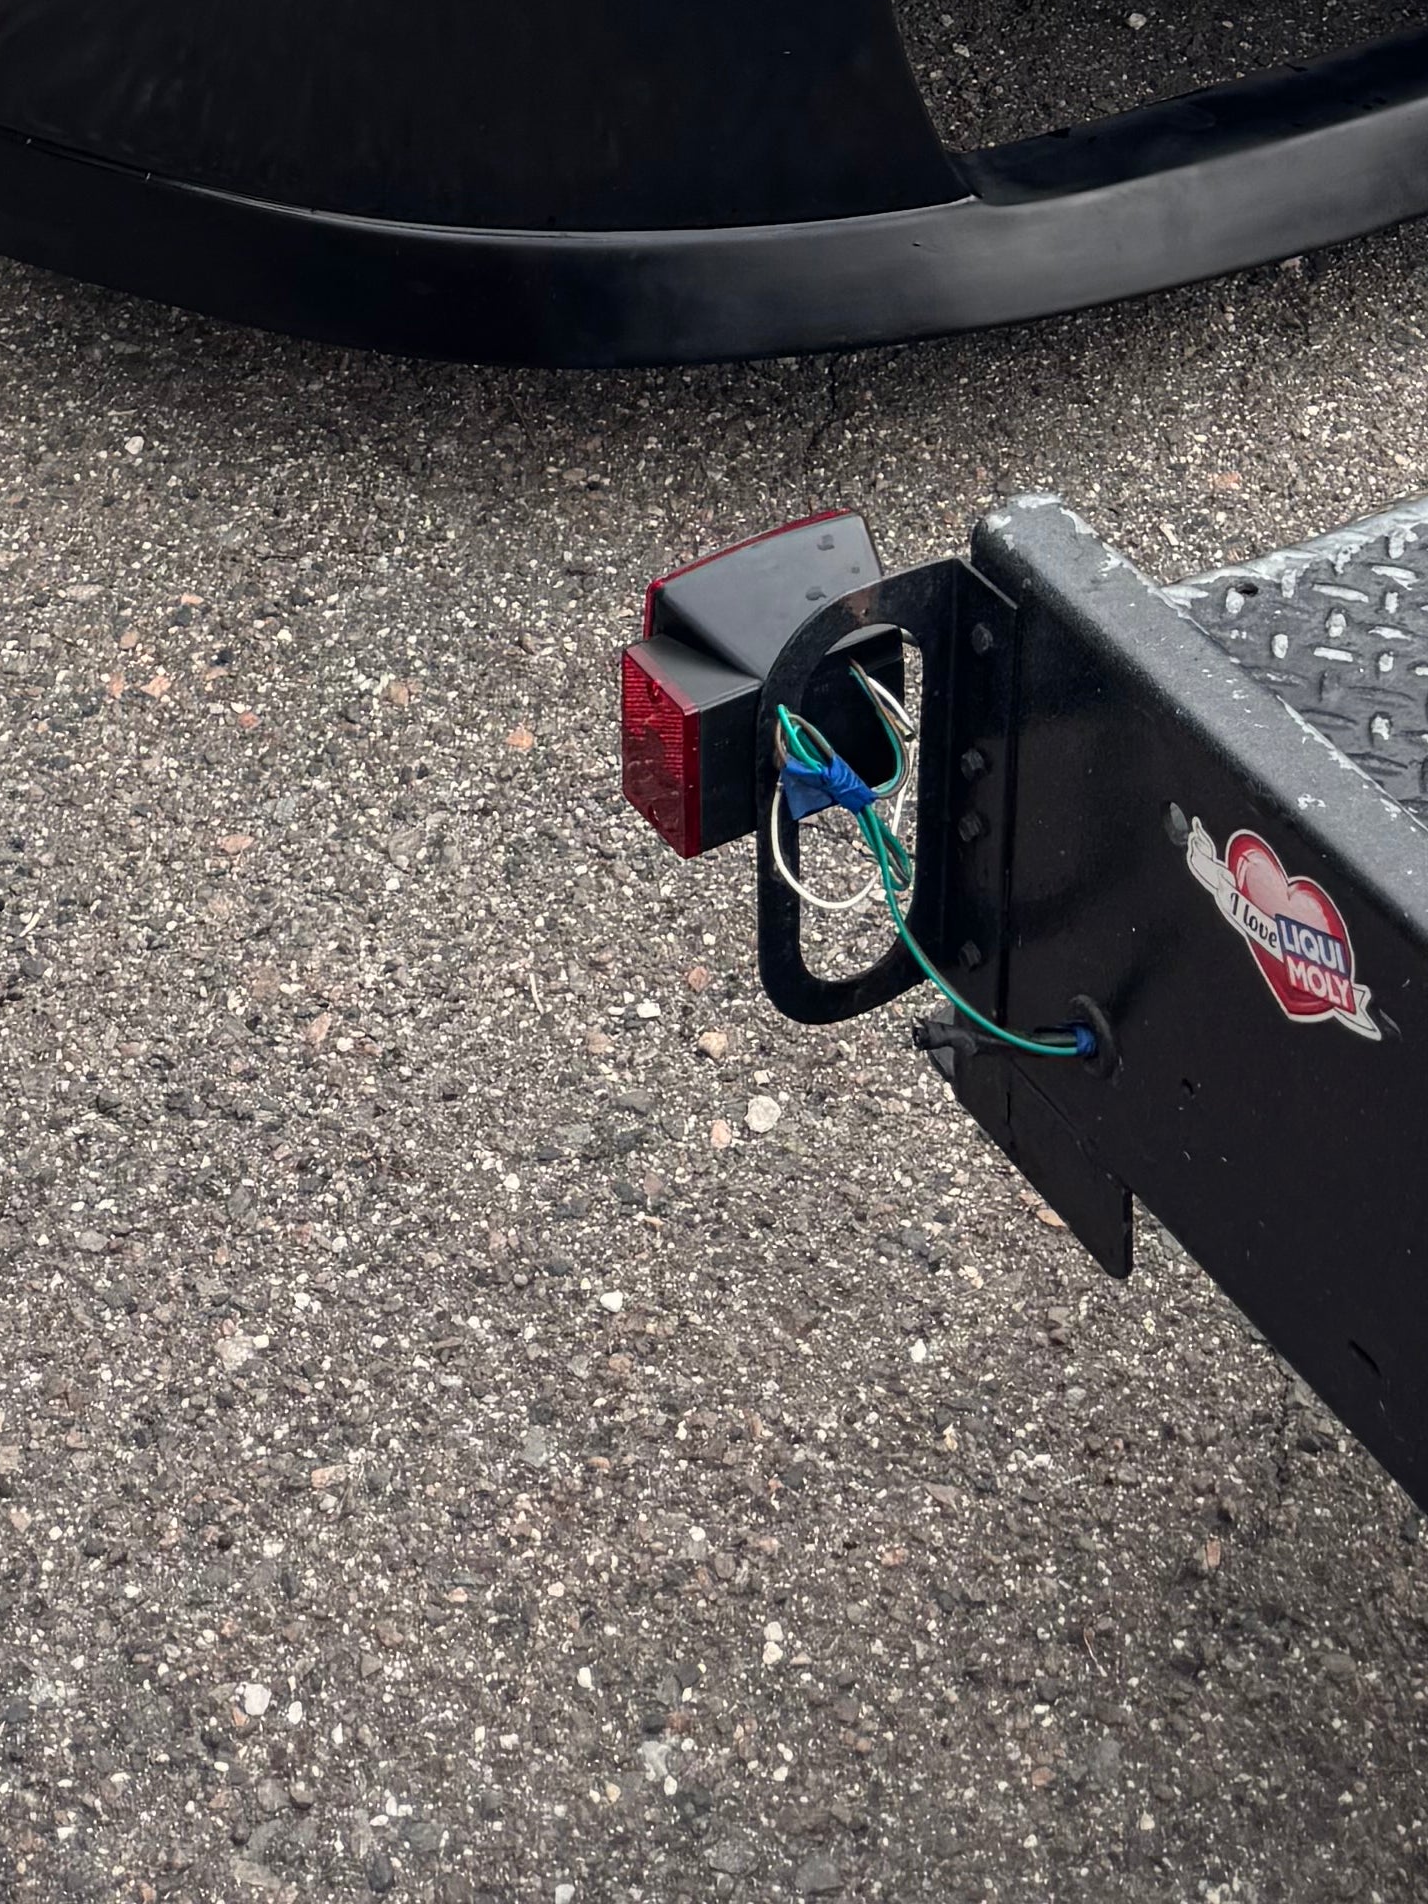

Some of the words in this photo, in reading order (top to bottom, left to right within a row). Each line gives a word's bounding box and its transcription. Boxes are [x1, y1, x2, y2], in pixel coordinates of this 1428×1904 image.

[1243, 904, 1278, 948] love
[1279, 919, 1346, 974] LIQUI
[1286, 955, 1349, 1008] MOLY
